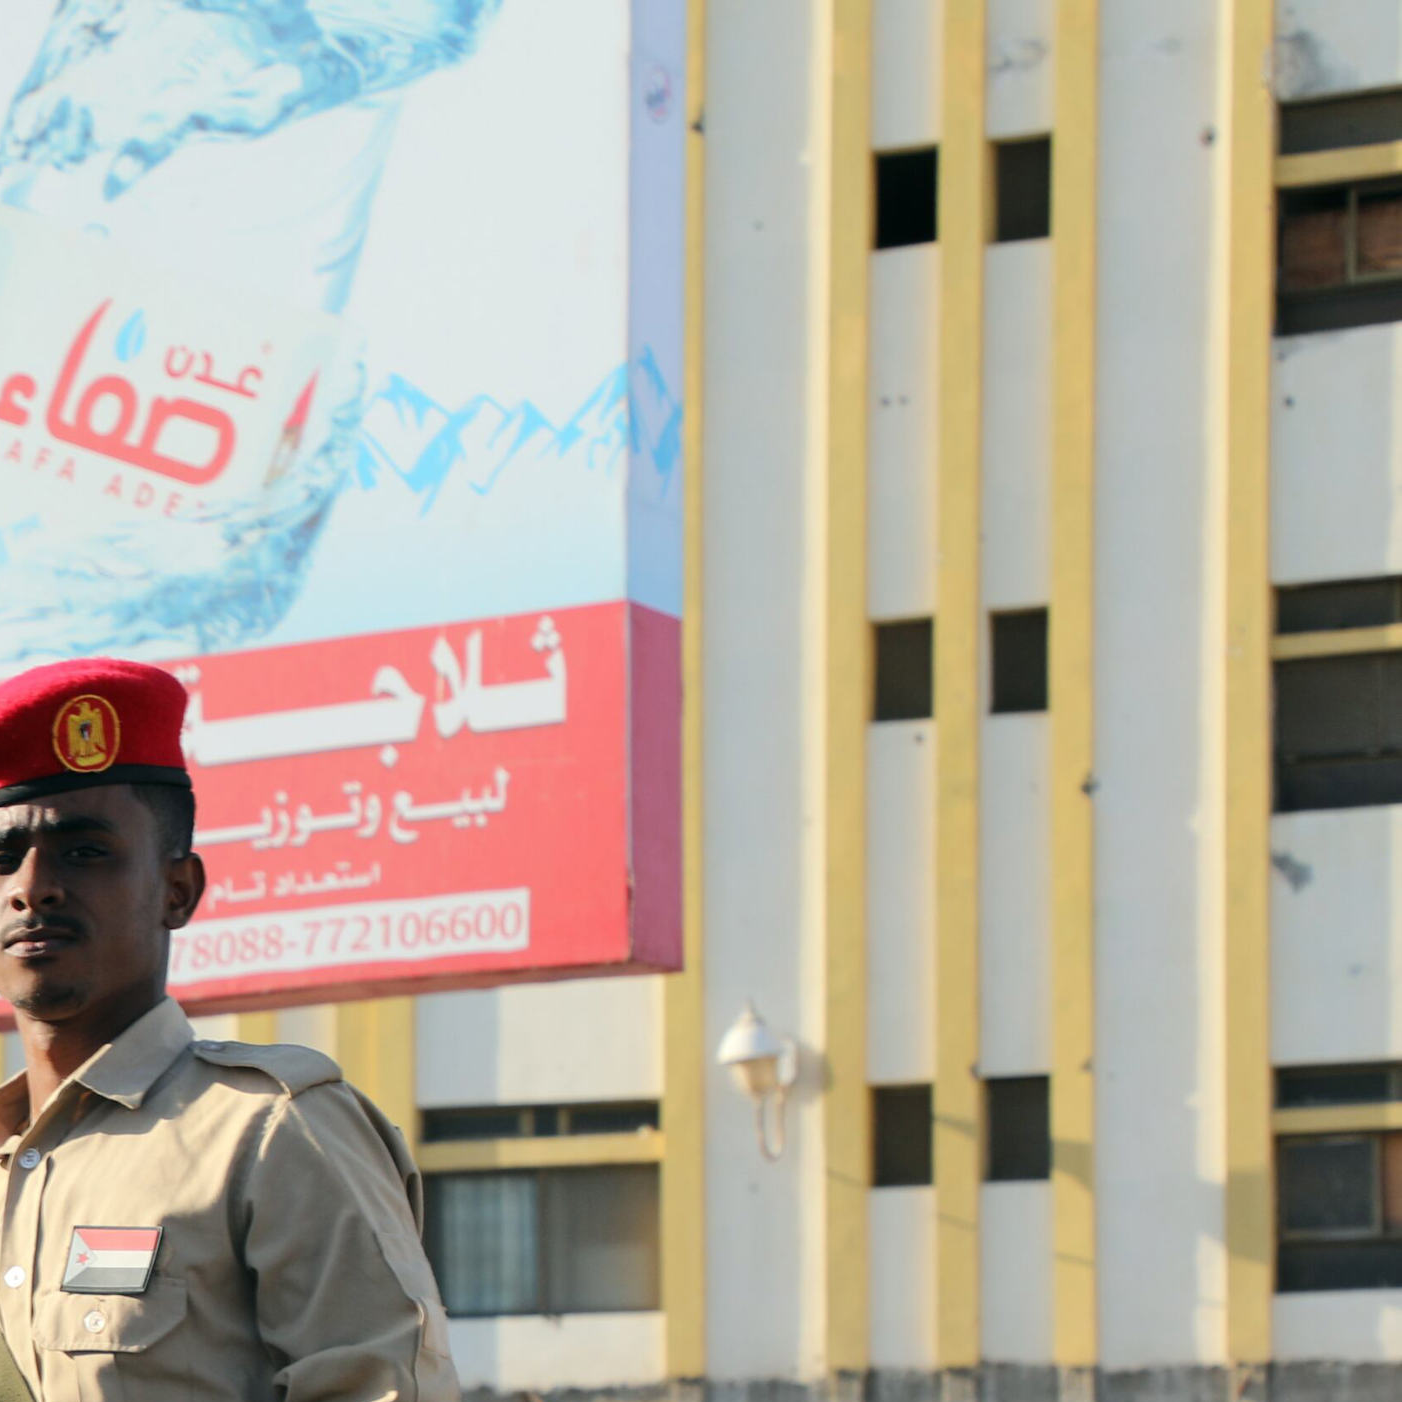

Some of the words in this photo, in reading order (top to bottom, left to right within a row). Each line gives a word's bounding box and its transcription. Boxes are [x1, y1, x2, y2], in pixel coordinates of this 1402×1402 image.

[104, 474, 208, 518] ADE
[192, 781, 382, 849] وتوزي
[390, 768, 509, 843] لبيع
